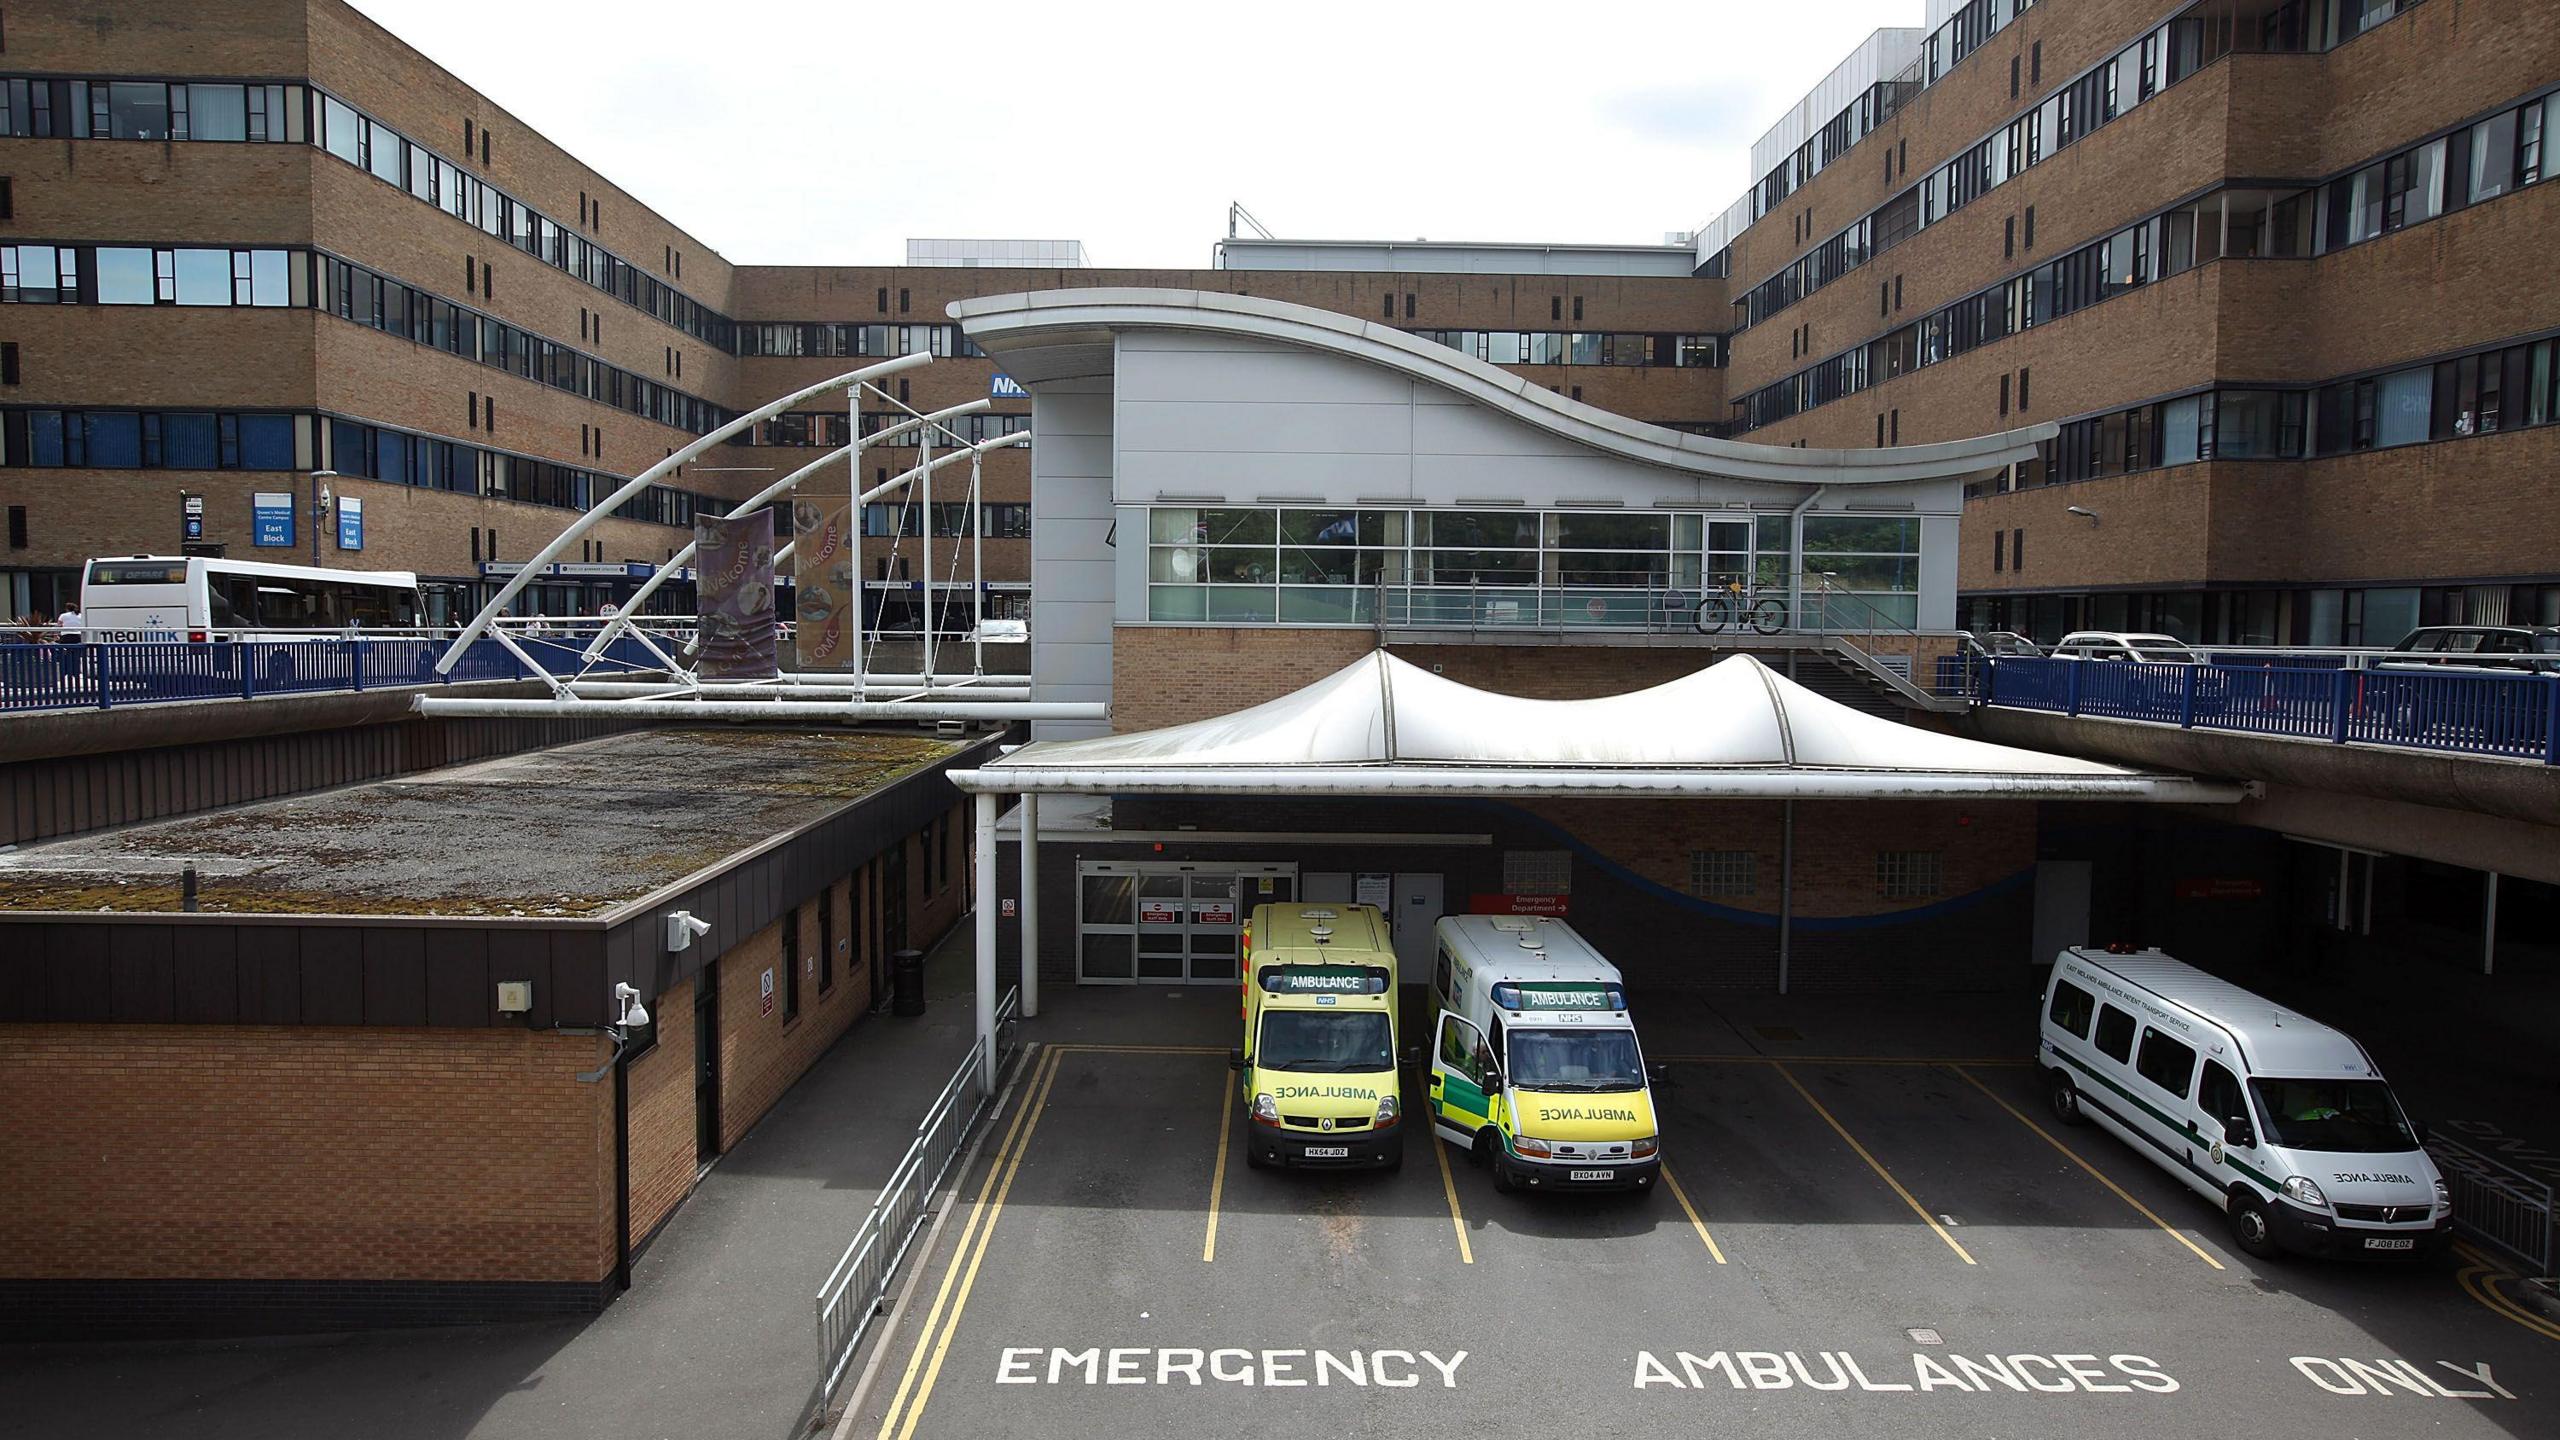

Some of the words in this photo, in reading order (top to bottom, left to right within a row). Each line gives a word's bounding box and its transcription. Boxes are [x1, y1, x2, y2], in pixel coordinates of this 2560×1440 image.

[993, 377, 1026, 394] NH
[263, 534, 285, 542] Block
[801, 526, 837, 571] Welcome
[703, 541, 749, 593] Welcome
[100, 626, 178, 643] medilink
[814, 629, 840, 658] QMC
[1516, 895, 1556, 904] Emergency
[1511, 904, 1556, 912] Department
[1291, 976, 1360, 989] AMBULANCE
[1531, 992, 1601, 1006] AMBULANCE
[2066, 963, 2077, 973] EAST
[2077, 968, 2097, 984] MIDLANDS
[2097, 980, 2124, 998] AMBULANCE
[2124, 992, 2141, 1006] PATIENT
[2141, 1001, 2169, 1021] TRANSPORT
[2169, 1016, 2190, 1032] SERVICE
[1559, 1014, 1582, 1022] NHS
[1573, 1171, 1595, 1179] BX04
[1596, 1171, 1613, 1179] AVN
[2368, 1240, 2392, 1248] FJ08
[995, 1347, 1468, 1388] EMERGENCY
[1634, 1350, 2182, 1394] AMBULANCES
[2288, 1355, 2518, 1400] ONLY
